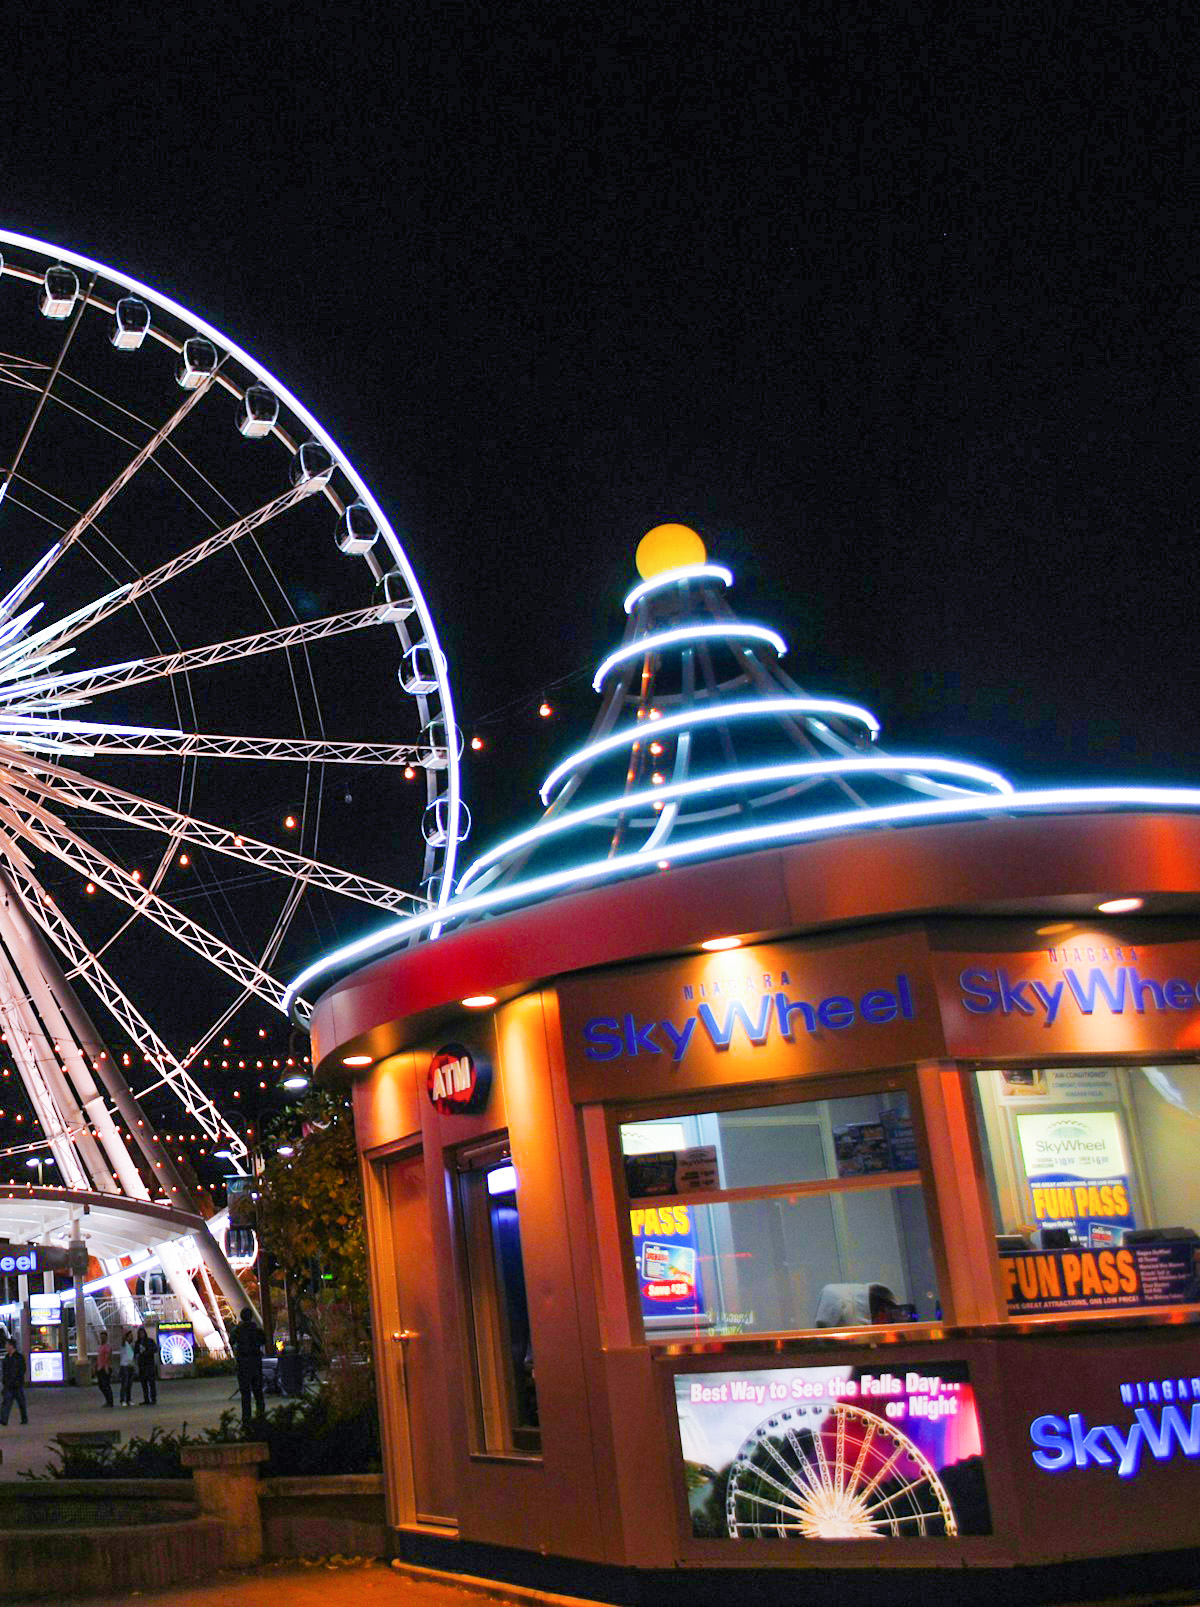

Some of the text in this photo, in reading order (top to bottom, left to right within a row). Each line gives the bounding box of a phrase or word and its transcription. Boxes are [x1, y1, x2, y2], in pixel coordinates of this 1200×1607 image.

[1048, 946, 1137, 963] NIAGARA
[682, 970, 790, 1001] NIAGARA
[959, 966, 1200, 1027] SkyWhe
[584, 974, 914, 1062] SkyWheel
[432, 1056, 471, 1101] ATM
[1035, 1139, 1106, 1154] SkyWheel
[1032, 1185, 1130, 1219] FUN PASS
[630, 1206, 690, 1236] PASS
[648, 1284, 670, 1296] Save
[1002, 1250, 1138, 1299] FUN PASS
[690, 1373, 960, 1404] Best Way to See the Falls Day...
[886, 1396, 958, 1420] or Night
